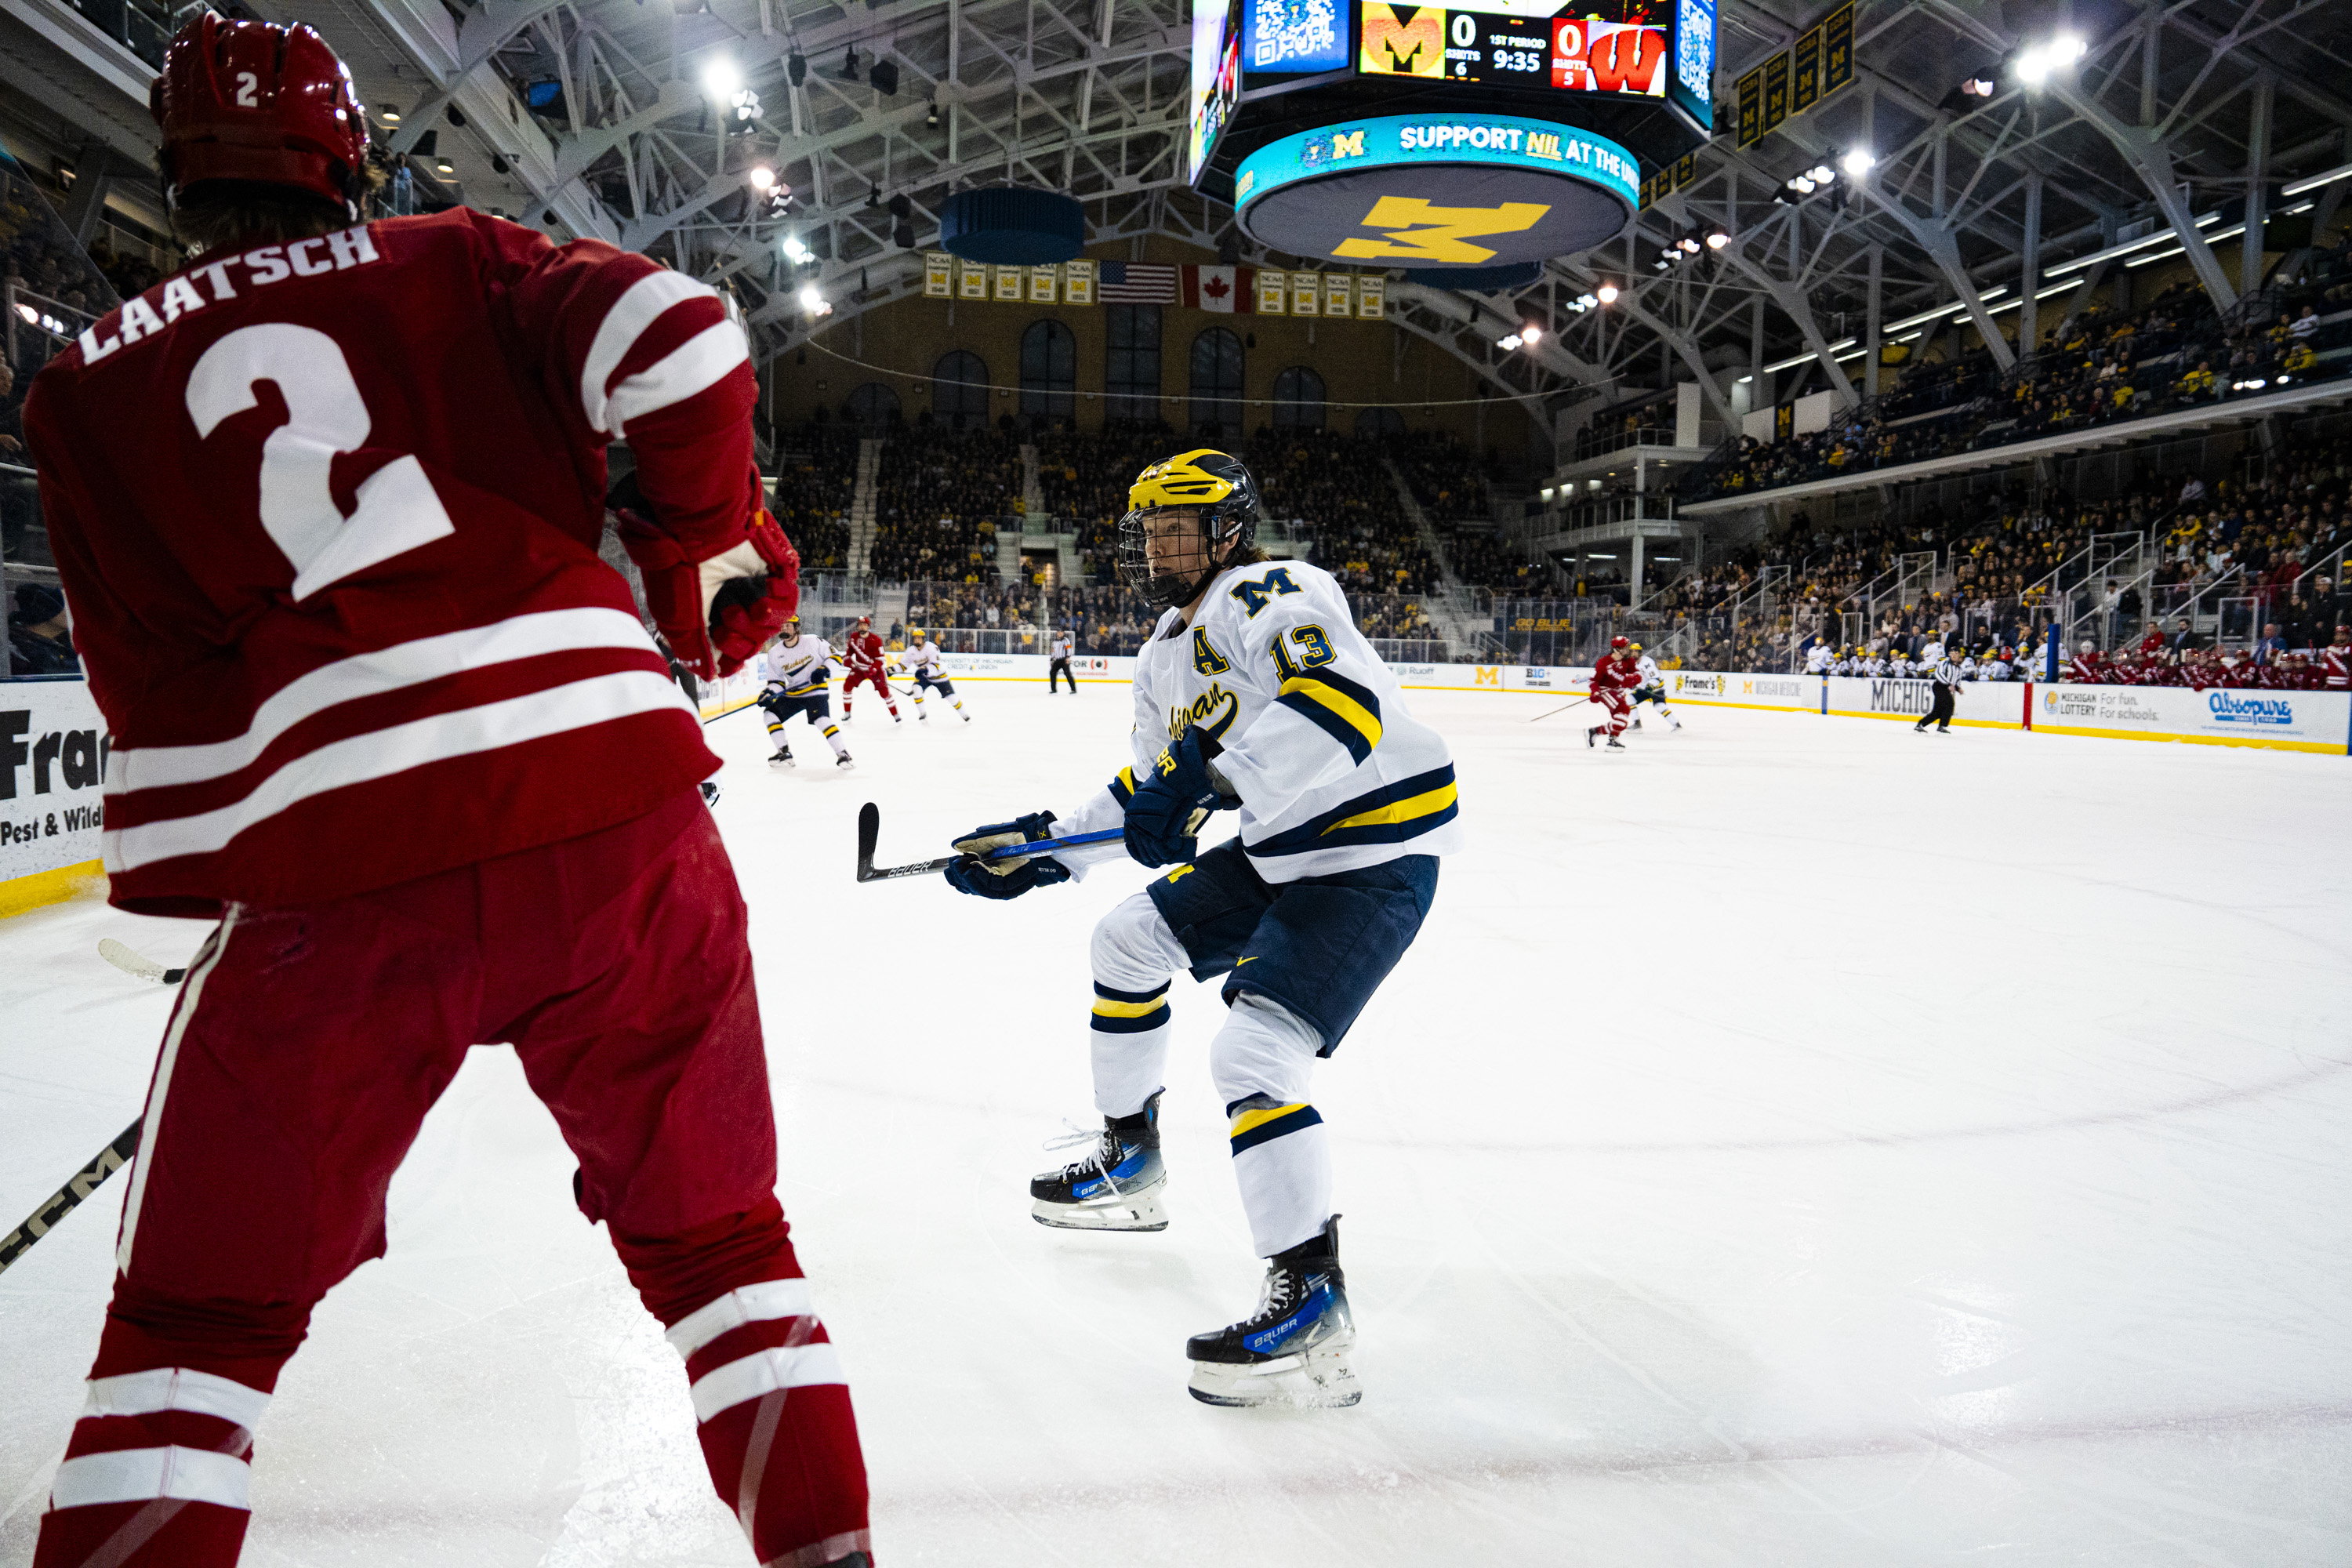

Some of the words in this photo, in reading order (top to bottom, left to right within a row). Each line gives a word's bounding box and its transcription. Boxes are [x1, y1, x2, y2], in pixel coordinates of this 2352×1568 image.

[1451, 14, 1476, 47] 0
[1558, 24, 1582, 56] 0
[1490, 35, 1508, 48] 1ST
[1511, 37, 1547, 49] PERIOD
[1445, 49, 1481, 61] SHOTS
[1493, 49, 1541, 72] 9:35
[1552, 58, 1588, 71] SHOTS
[1455, 63, 1467, 75] 6
[1563, 72, 1574, 85] 5
[236, 71, 257, 107] 2
[1333, 131, 1364, 158] M
[1400, 126, 1519, 150] SUPPORT
[1526, 132, 1563, 160] NIL
[1565, 140, 1592, 163] AT
[1594, 147, 1621, 176] THE
[79, 225, 379, 365] LAATSCH
[1778, 406, 1791, 426] M
[185, 322, 456, 603] 2
[1225, 521, 1243, 538] BAUER
[1230, 568, 1303, 619] M
[1537, 619, 1571, 627] BLUE
[1192, 626, 1231, 677] A
[1269, 624, 1337, 684] 13
[1475, 666, 1499, 684] M
[1685, 675, 1716, 690] Frame's
[1744, 680, 1753, 694] M
[2061, 692, 2097, 703] MICHIGAN
[2101, 692, 2117, 705] For
[2118, 691, 2139, 706] fun.
[2060, 704, 2096, 717] LOTTERY
[2100, 707, 2116, 719] For
[2118, 707, 2160, 721] schools.
[2209, 691, 2292, 725] Absopure
[1, 817, 39, 846] Pest
[45, 812, 59, 837] &
[887, 859, 934, 878] BAUER
[0, 1145, 125, 1275] CCM
[1254, 1318, 1298, 1348] BAUER
